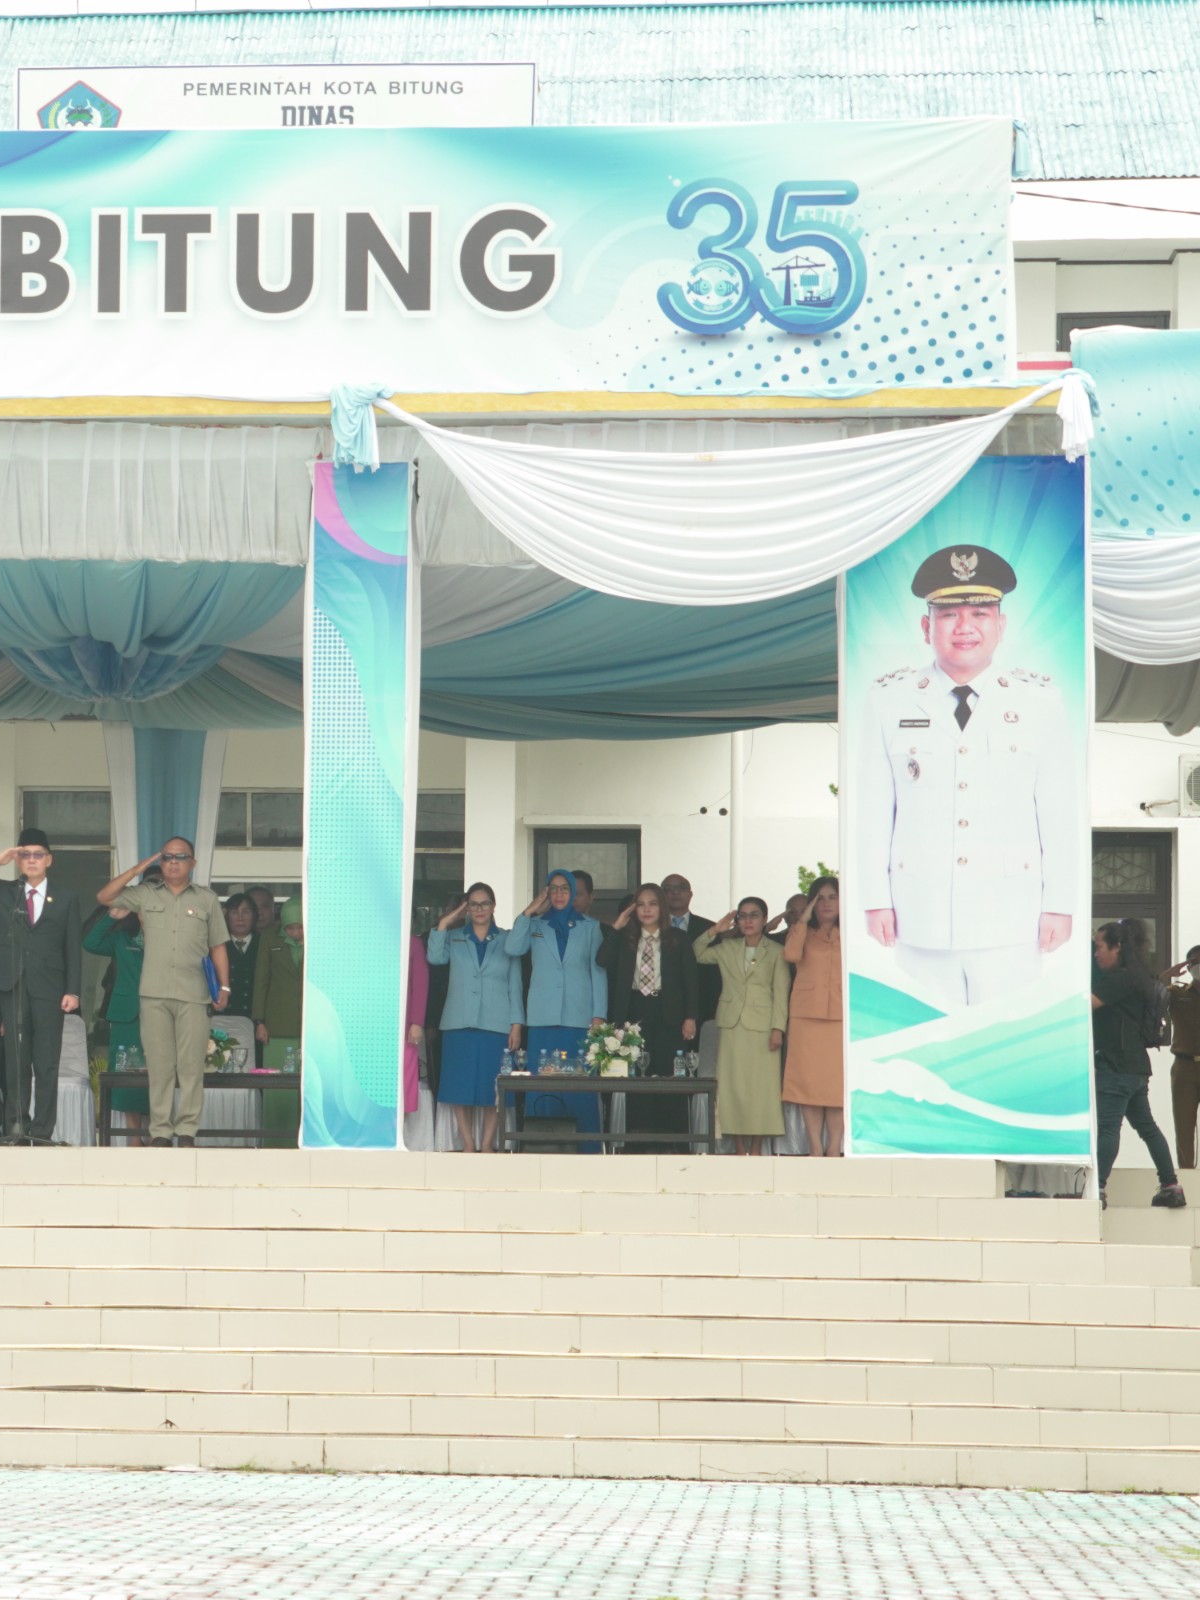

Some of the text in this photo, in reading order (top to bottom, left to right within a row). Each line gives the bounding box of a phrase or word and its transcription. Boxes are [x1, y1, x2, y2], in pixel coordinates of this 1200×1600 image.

[183, 81, 464, 96] PEMERINTAH KOTA BITUNG
[281, 105, 354, 126] DINAS
[0, 209, 555, 314] BITUNG
[657, 178, 867, 335] 35
